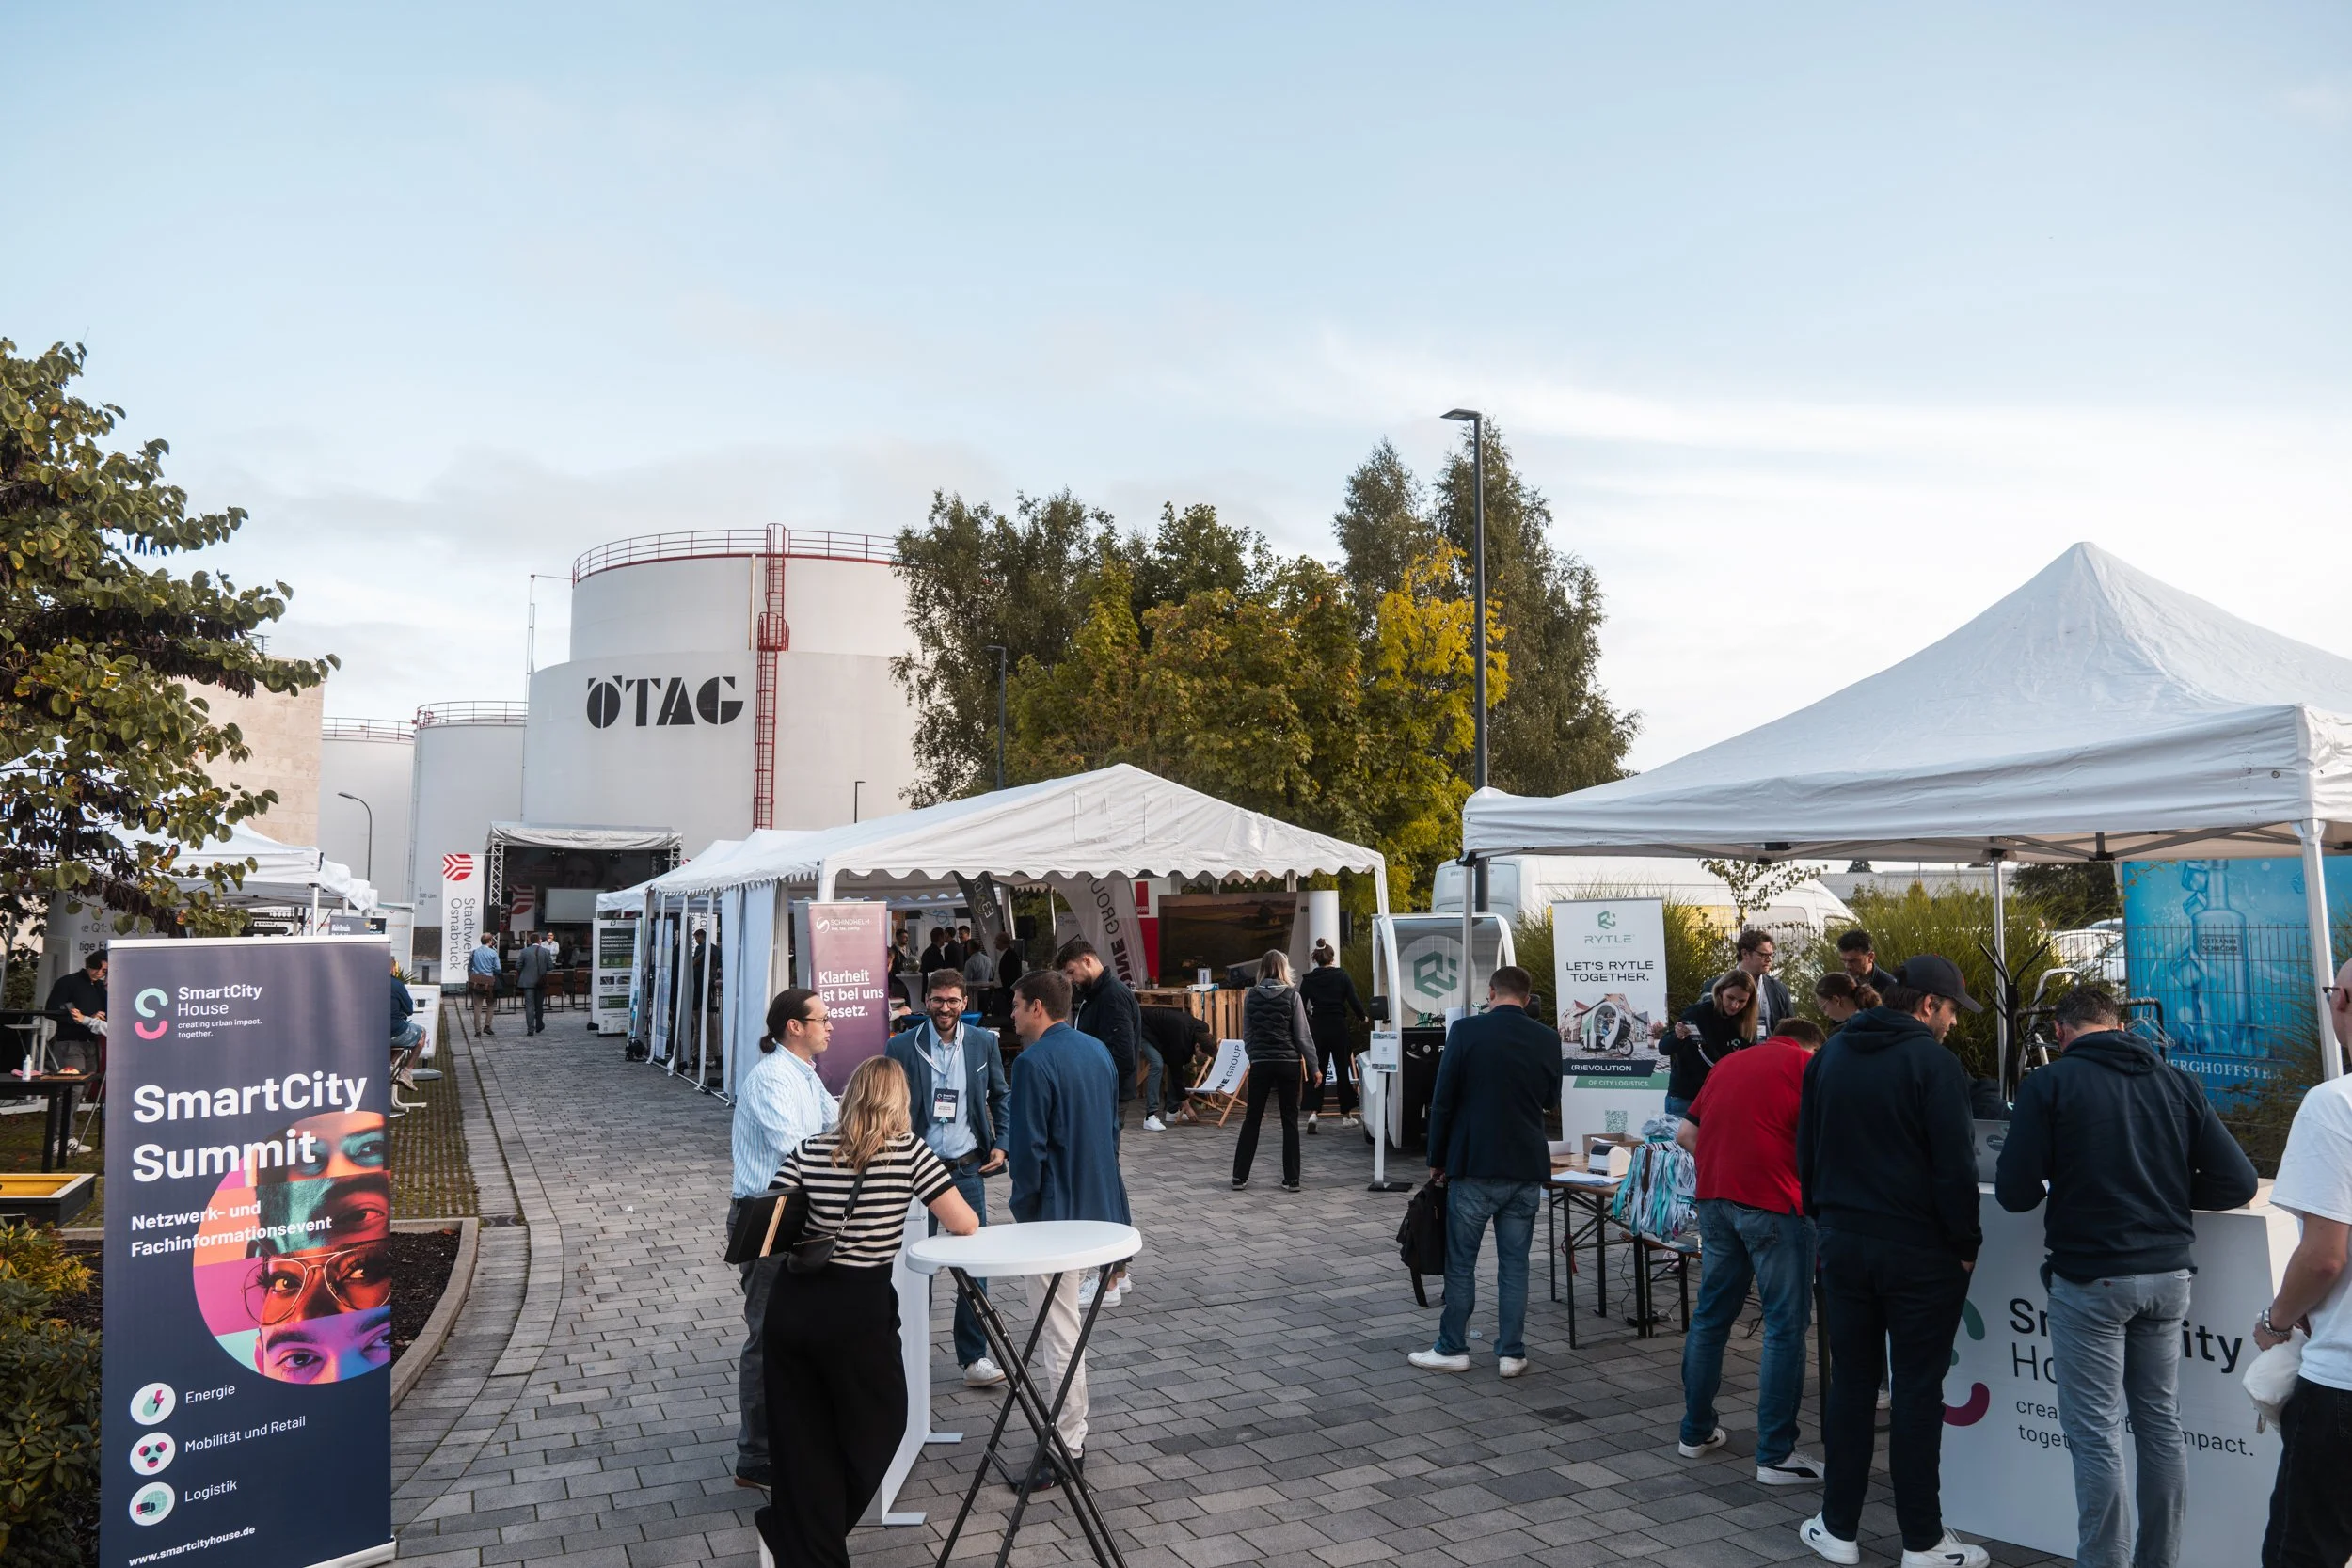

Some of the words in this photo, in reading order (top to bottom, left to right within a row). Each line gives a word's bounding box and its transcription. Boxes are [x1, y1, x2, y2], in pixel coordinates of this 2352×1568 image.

[449, 897, 463, 971] Osnabrück
[1584, 934, 1632, 944] RYTLE
[818, 969, 870, 984] Klarheit
[1608, 960, 1654, 971] RYTLE
[1570, 973, 1649, 982] TOGETHER.
[178, 984, 262, 1001] SmartCity
[820, 989, 835, 1002] ist
[838, 987, 859, 1001] bei
[862, 988, 884, 1000] uns
[178, 1003, 229, 1017] House
[178, 1020, 210, 1030] creating
[211, 1020, 233, 1028] urban
[234, 1018, 262, 1027] impact.
[178, 1030, 214, 1039] together.
[1227, 1044, 1242, 1078] GROUP
[133, 1070, 368, 1124] SmartCity
[132, 1128, 317, 1183] Summit
[131, 1207, 226, 1231] Netzwerk-
[229, 1200, 262, 1218] und
[131, 1216, 333, 1258] Fachinformationsevent
[185, 1384, 236, 1405] Energie
[2016, 1400, 2058, 1420] crea
[185, 1429, 242, 1453] Mobilität
[244, 1423, 268, 1440] und
[270, 1415, 307, 1434] Retail
[2018, 1424, 2070, 1449] toget
[2182, 1430, 2254, 1457] mpact.
[184, 1479, 238, 1503] Logistik
[129, 1525, 256, 1568] www.smartcityhouse.de
